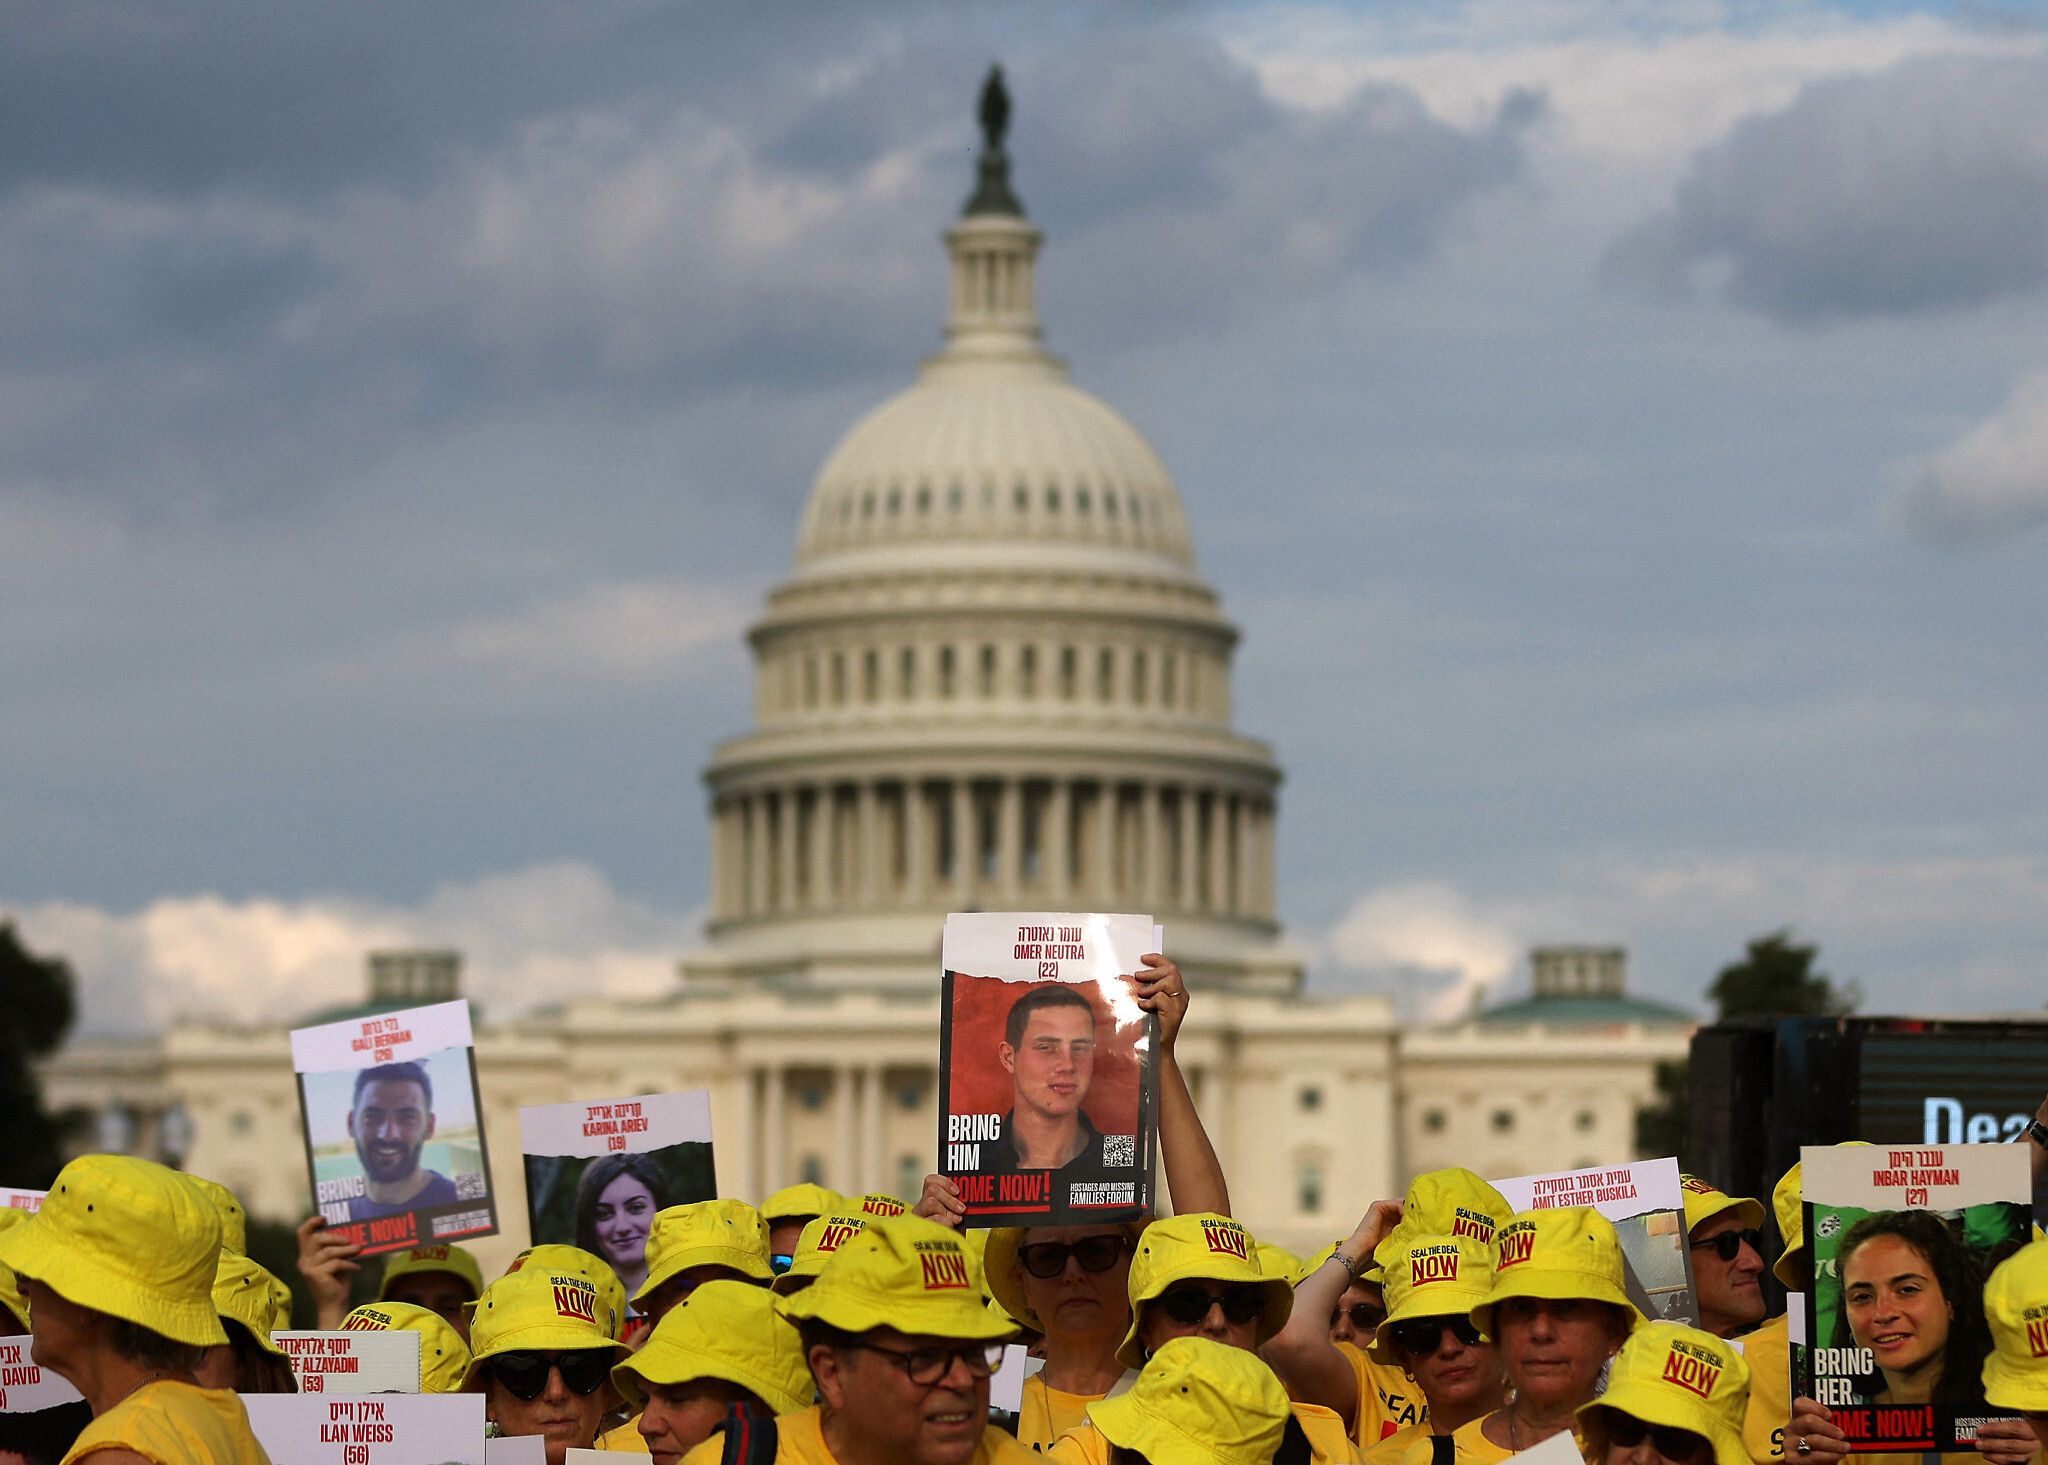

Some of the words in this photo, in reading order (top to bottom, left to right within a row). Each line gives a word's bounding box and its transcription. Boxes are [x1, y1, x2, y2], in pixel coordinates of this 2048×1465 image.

[1019, 926, 1054, 942] נאוטרה
[1058, 927, 1081, 942] עומר
[1014, 944, 1042, 960] OMER
[1045, 945, 1085, 960] NEUTRA
[1038, 961, 1058, 979] (22)
[614, 1103, 642, 1118] קרינה
[583, 1121, 619, 1137] KARINA
[621, 1118, 648, 1133] ARIEV
[948, 1114, 1001, 1142] BRING
[948, 1144, 980, 1171] HIM
[1916, 1151, 1943, 1167] ענבר
[1000, 1171, 1050, 1202] NOW!
[1070, 1183, 1098, 1192] HOSTAGES
[1099, 1182, 1110, 1192] AND
[1111, 1182, 1134, 1191] MISSING
[1533, 1177, 1574, 1195] בוסקילה
[1576, 1173, 1604, 1189] אסתר
[1606, 1170, 1631, 1186] עמית
[1873, 1170, 1908, 1186] INBAR
[1911, 1170, 1959, 1186] HAYMAN
[317, 1175, 365, 1204] BRING
[1069, 1192, 1105, 1205] FAMILIES
[1106, 1191, 1134, 1204] FORUM
[1532, 1195, 1555, 1210] AMIT
[1558, 1190, 1594, 1208] ESTHER
[1596, 1185, 1637, 1202] BUSKILA
[1906, 1188, 1928, 1206] (27)
[320, 1200, 351, 1226] HIM
[829, 1217, 845, 1225] SEAL
[1456, 1207, 1472, 1219] SEAL
[1472, 1211, 1483, 1223] THE
[1483, 1216, 1496, 1229] DEAL
[370, 1212, 417, 1243] NOW!
[1200, 1219, 1218, 1228] SEAL
[1218, 1220, 1230, 1230] THE
[1229, 1222, 1245, 1233] DEAL
[1452, 1218, 1494, 1245] NOW
[818, 1225, 860, 1248] NO
[1204, 1227, 1246, 1256] NOW
[1411, 1249, 1428, 1259] SEAL
[1429, 1246, 1441, 1255] THE
[1442, 1245, 1459, 1254] DEAL
[1498, 1232, 1535, 1267] NOW
[920, 1253, 969, 1286] NOW
[1412, 1255, 1458, 1282] NOW
[550, 1277, 569, 1286] SEAL
[568, 1278, 581, 1289] THE
[580, 1280, 597, 1295] DEAL
[553, 1286, 595, 1319] NOW
[302, 1357, 359, 1373] ALZAYADNI
[1814, 1347, 1874, 1376] BRING
[2, 1366, 41, 1386] DAVID
[1664, 1351, 1720, 1394] NOW
[303, 1375, 324, 1393] (53)
[1815, 1378, 1853, 1405] HER
[330, 1403, 354, 1421] וייס
[358, 1402, 384, 1423] אילן
[1830, 1410, 1871, 1438] OME
[1876, 1406, 1934, 1438] NOW!
[320, 1424, 349, 1443] ILAN
[352, 1424, 394, 1443] WEISS
[343, 1444, 370, 1465] (56)
